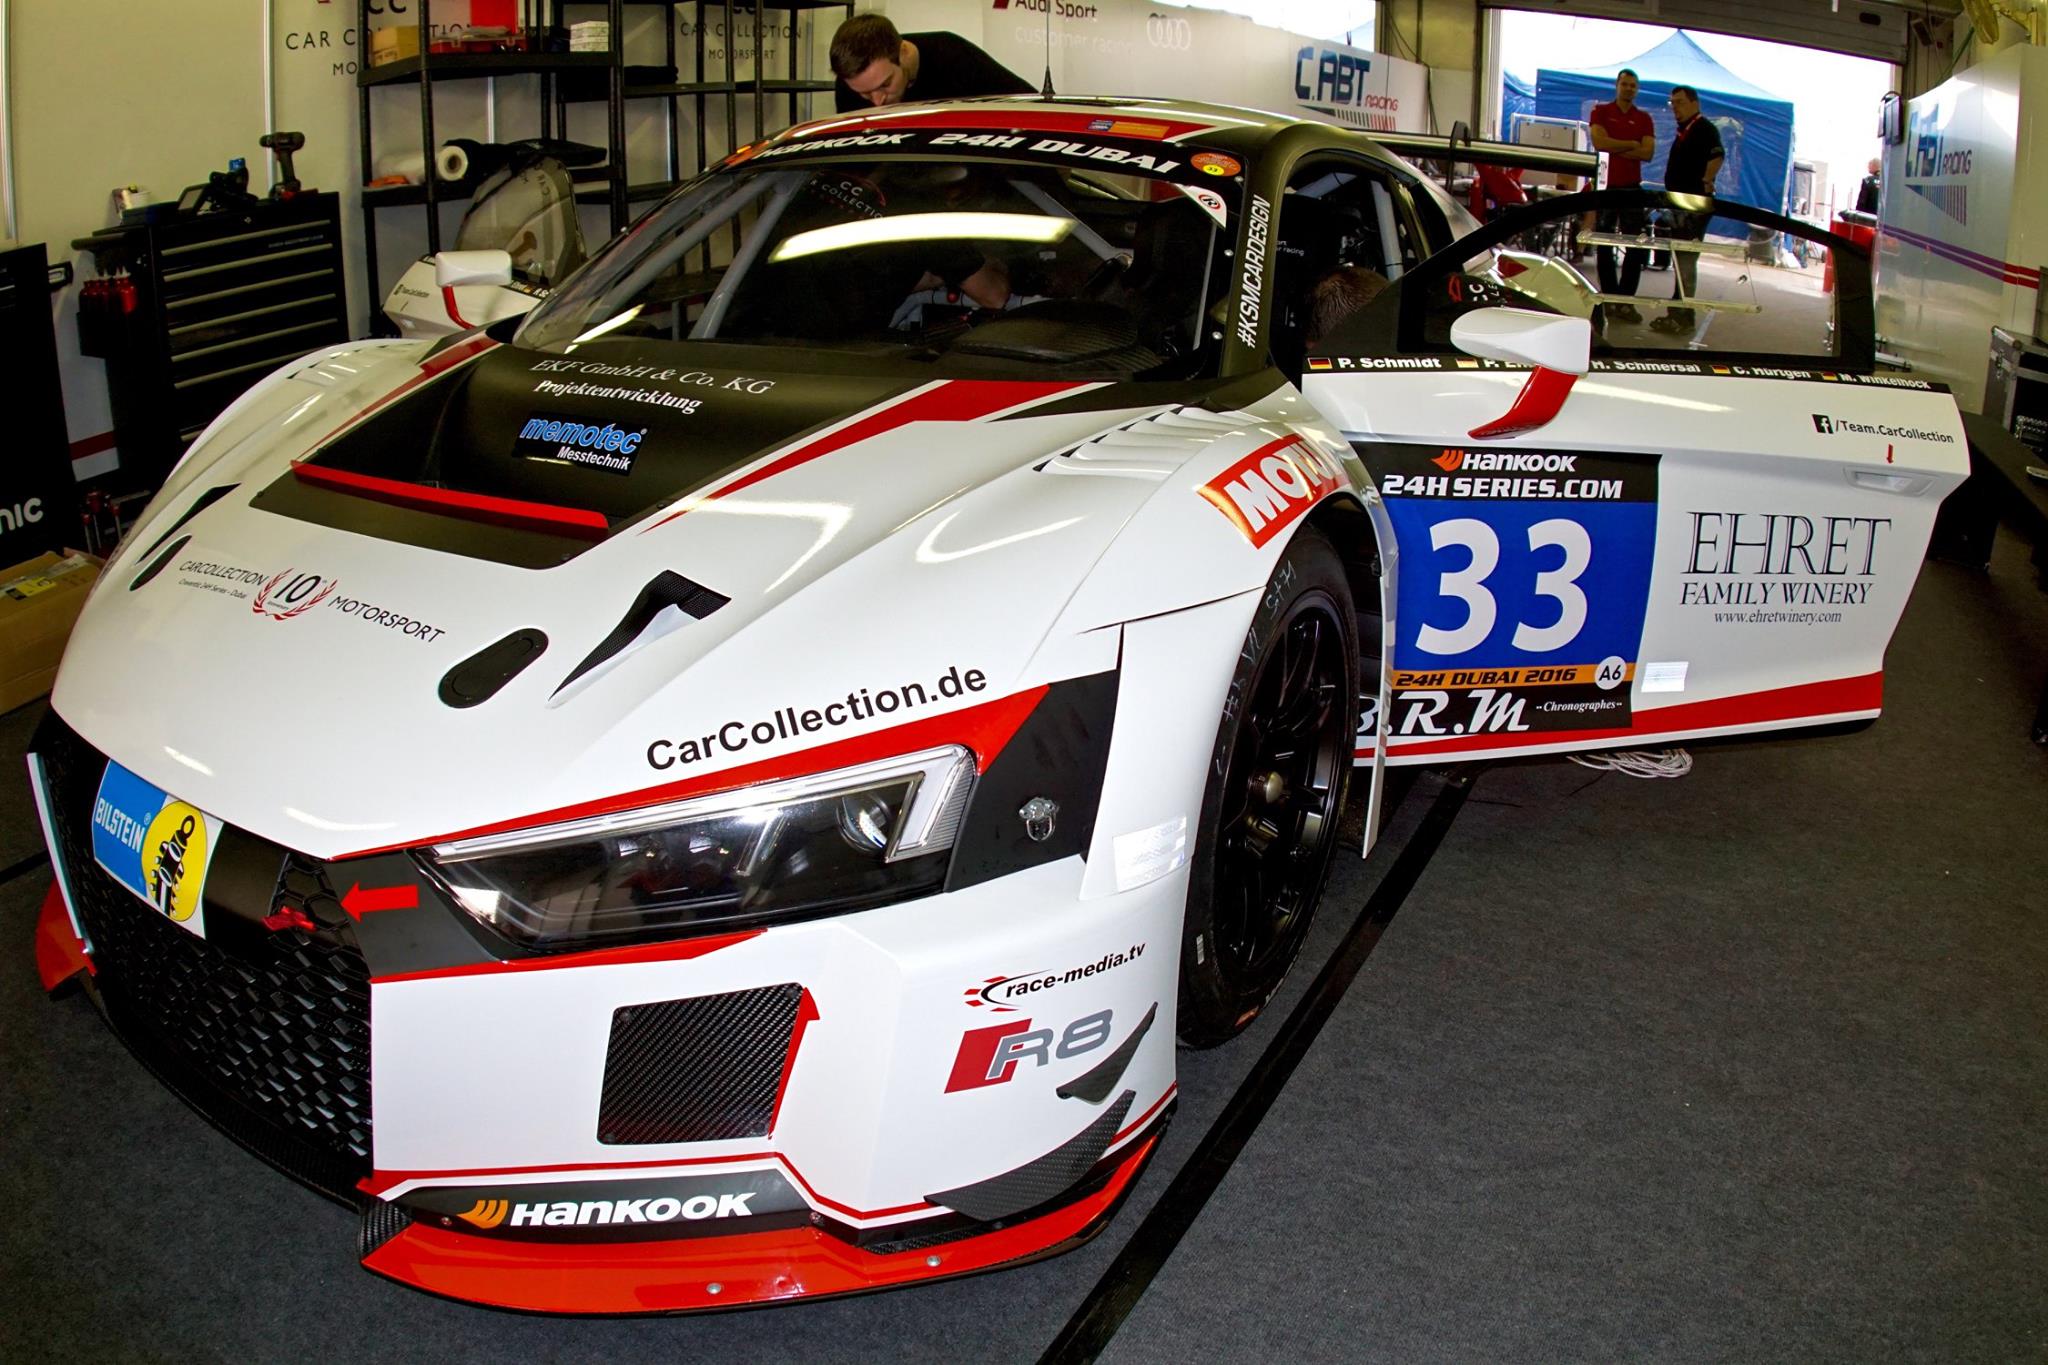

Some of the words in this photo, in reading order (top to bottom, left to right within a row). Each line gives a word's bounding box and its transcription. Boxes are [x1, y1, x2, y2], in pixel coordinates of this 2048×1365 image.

[1056, 0, 1098, 18] Sport
[286, 31, 331, 50] CAR
[929, 133, 1027, 148] 24H
[1028, 139, 1181, 174] DUBAI
[821, 183, 885, 219] COLLECTIO
[1237, 194, 1271, 349] #KSMCARDESIGN
[580, 362, 651, 379] GmbH
[650, 368, 677, 380] &
[679, 370, 715, 386] Co.
[722, 377, 776, 395] KG
[1360, 357, 1442, 369] Schmidt
[533, 380, 704, 415] Projektentwicklung
[557, 445, 632, 471] Messtechnik
[1381, 474, 1449, 498] 24H
[1453, 477, 1624, 499] SERIES.COM
[1680, 511, 1892, 576] EHRET
[178, 560, 270, 587] CARCOLLECTION
[327, 595, 446, 644] MOTORSPORT
[1415, 518, 1592, 655] 33
[1680, 582, 1776, 606] FAMILY
[1782, 582, 1874, 606] WINERY
[1714, 608, 1842, 626] www.ehretwinery.com
[1395, 672, 1446, 688] 24H
[1451, 670, 1520, 686] DUBAI
[1524, 667, 1579, 683] 2016
[1598, 664, 1623, 682] A6
[646, 666, 988, 771] CarCollection.de
[95, 797, 146, 854] BILSTEIN
[1005, 943, 1146, 998] race-media.tv
[986, 1009, 1113, 1078] R8
